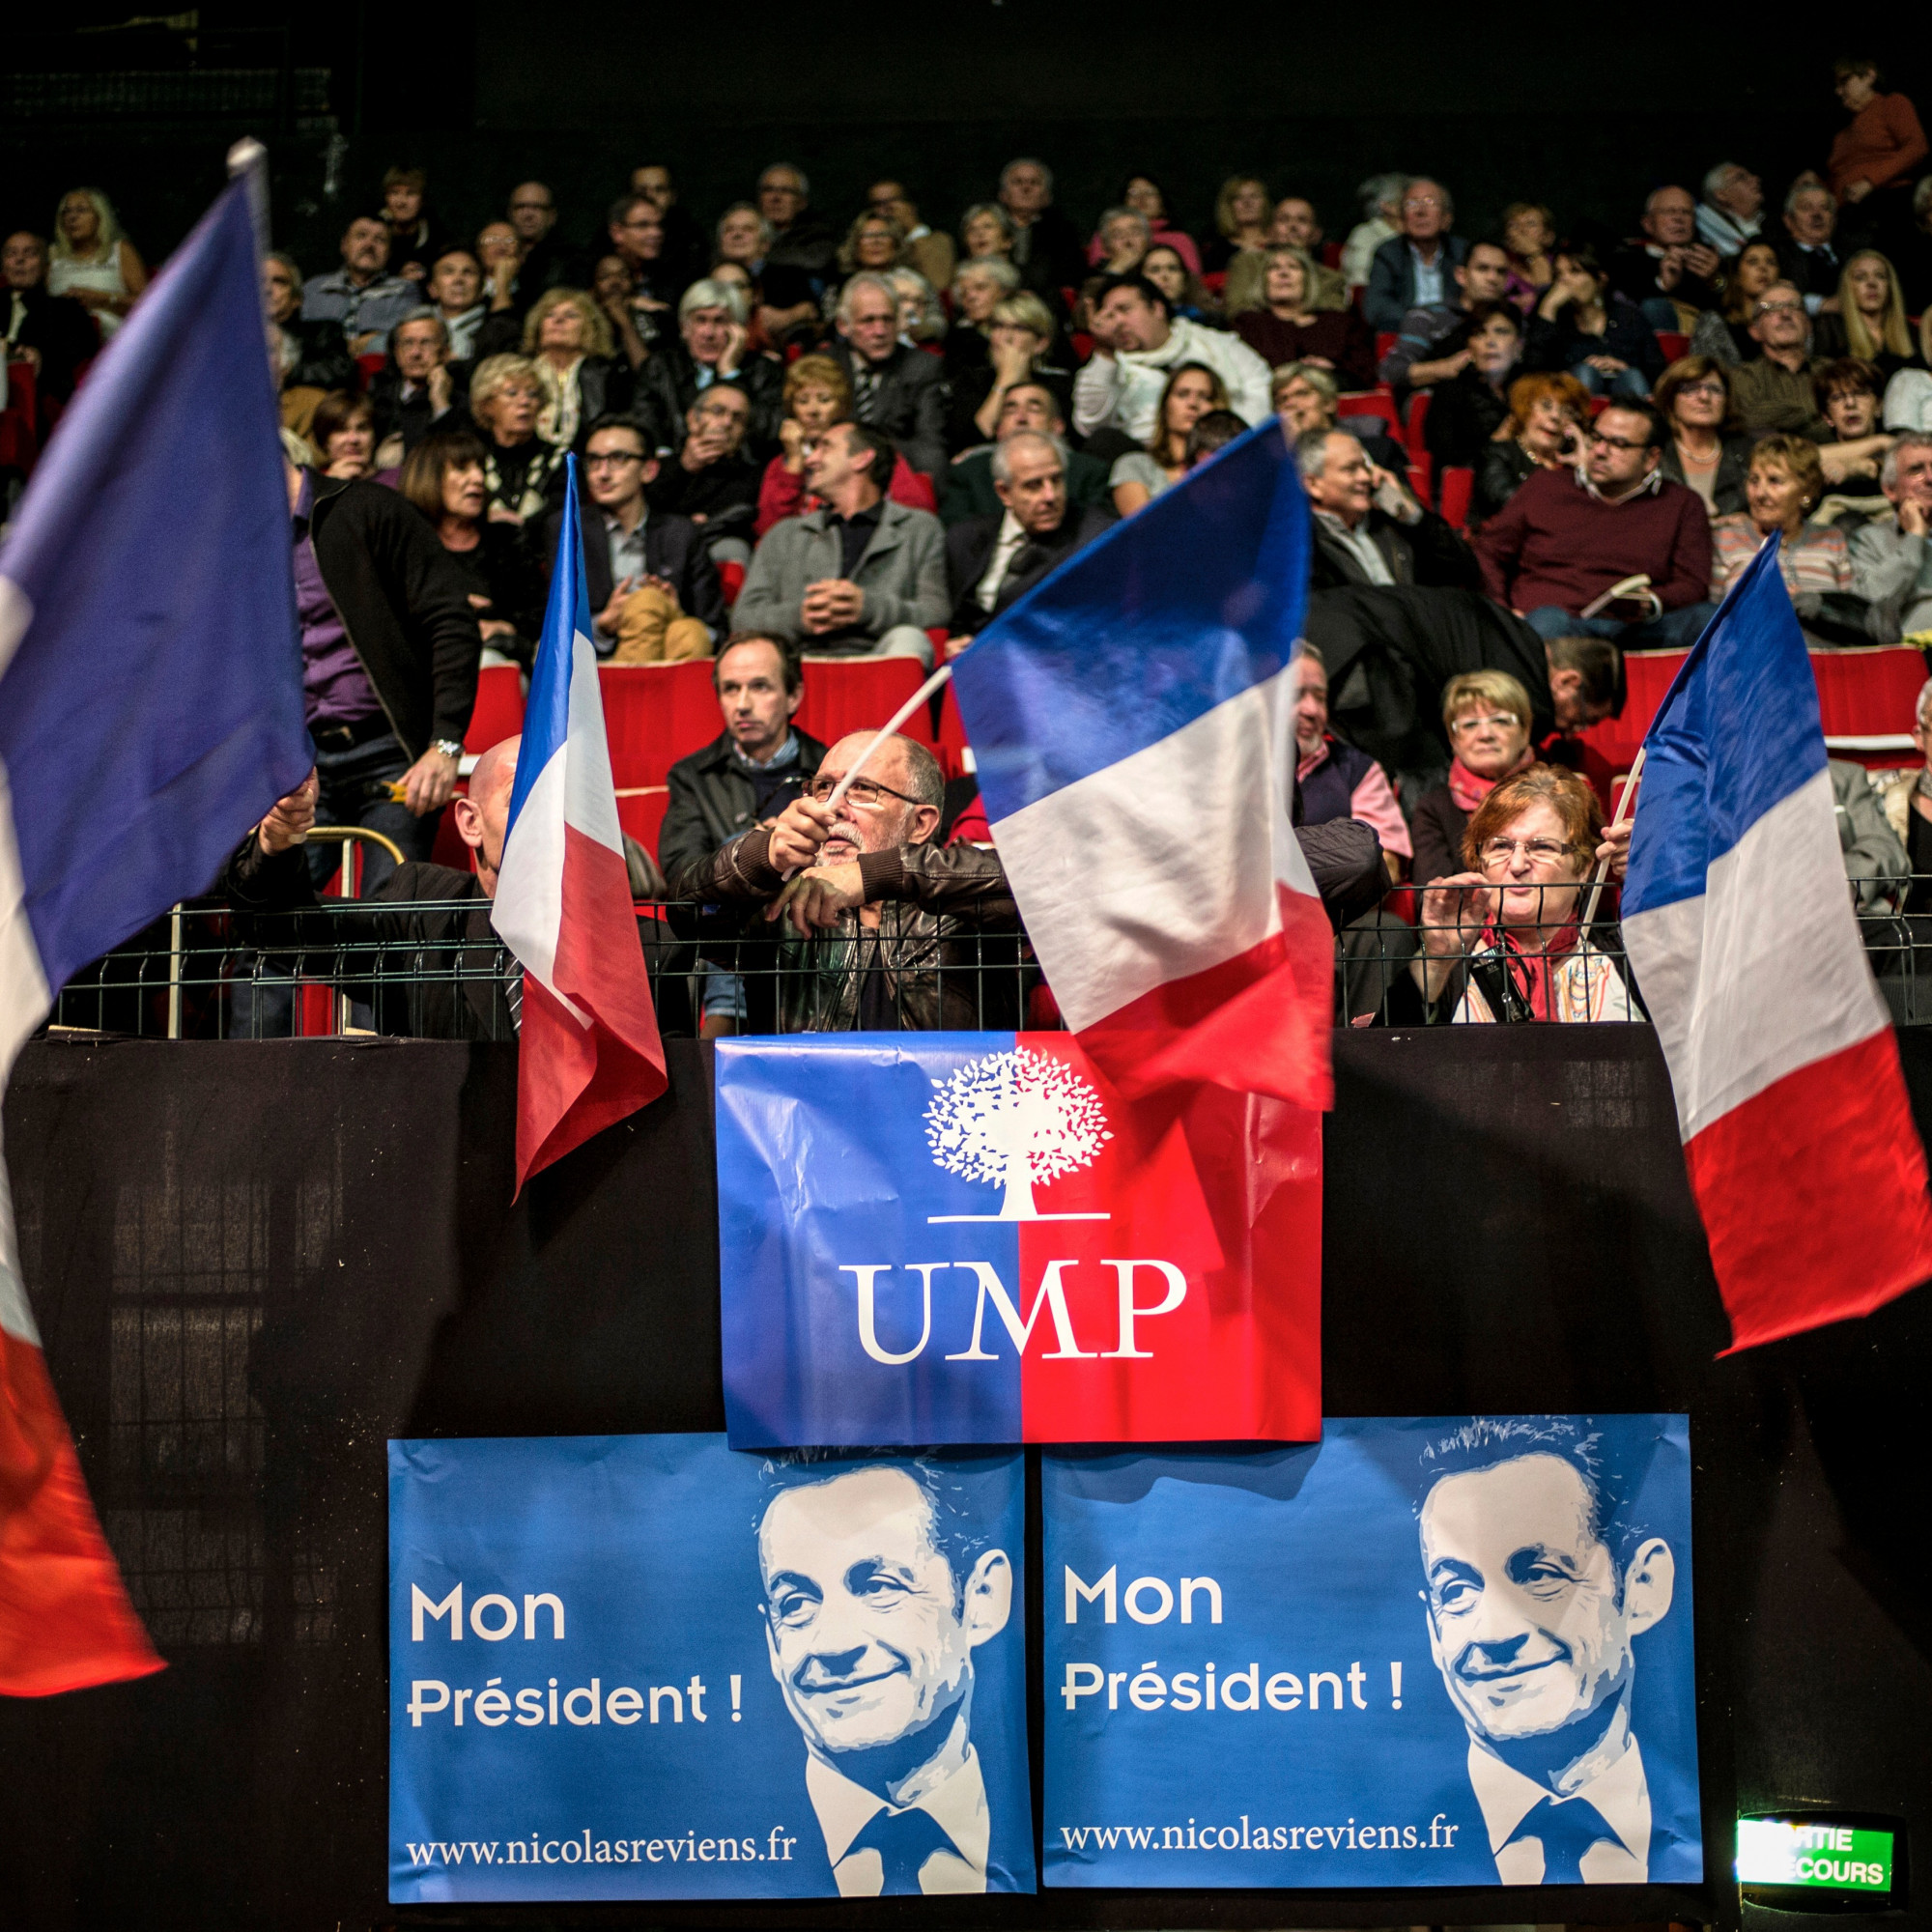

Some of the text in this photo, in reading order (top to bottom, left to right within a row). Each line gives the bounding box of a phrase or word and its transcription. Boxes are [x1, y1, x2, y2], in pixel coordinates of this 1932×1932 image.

[838, 1259, 1187, 1365] UMP
[411, 1581, 565, 1642] Mon
[1065, 1563, 1223, 1626] Mon
[406, 1673, 742, 1727] Président !
[1061, 1660, 1403, 1712] Président !
[406, 1825, 797, 1867] www.nicolasreviens.fr
[1060, 1812, 1460, 1851] www.nicolasreviens.fr
